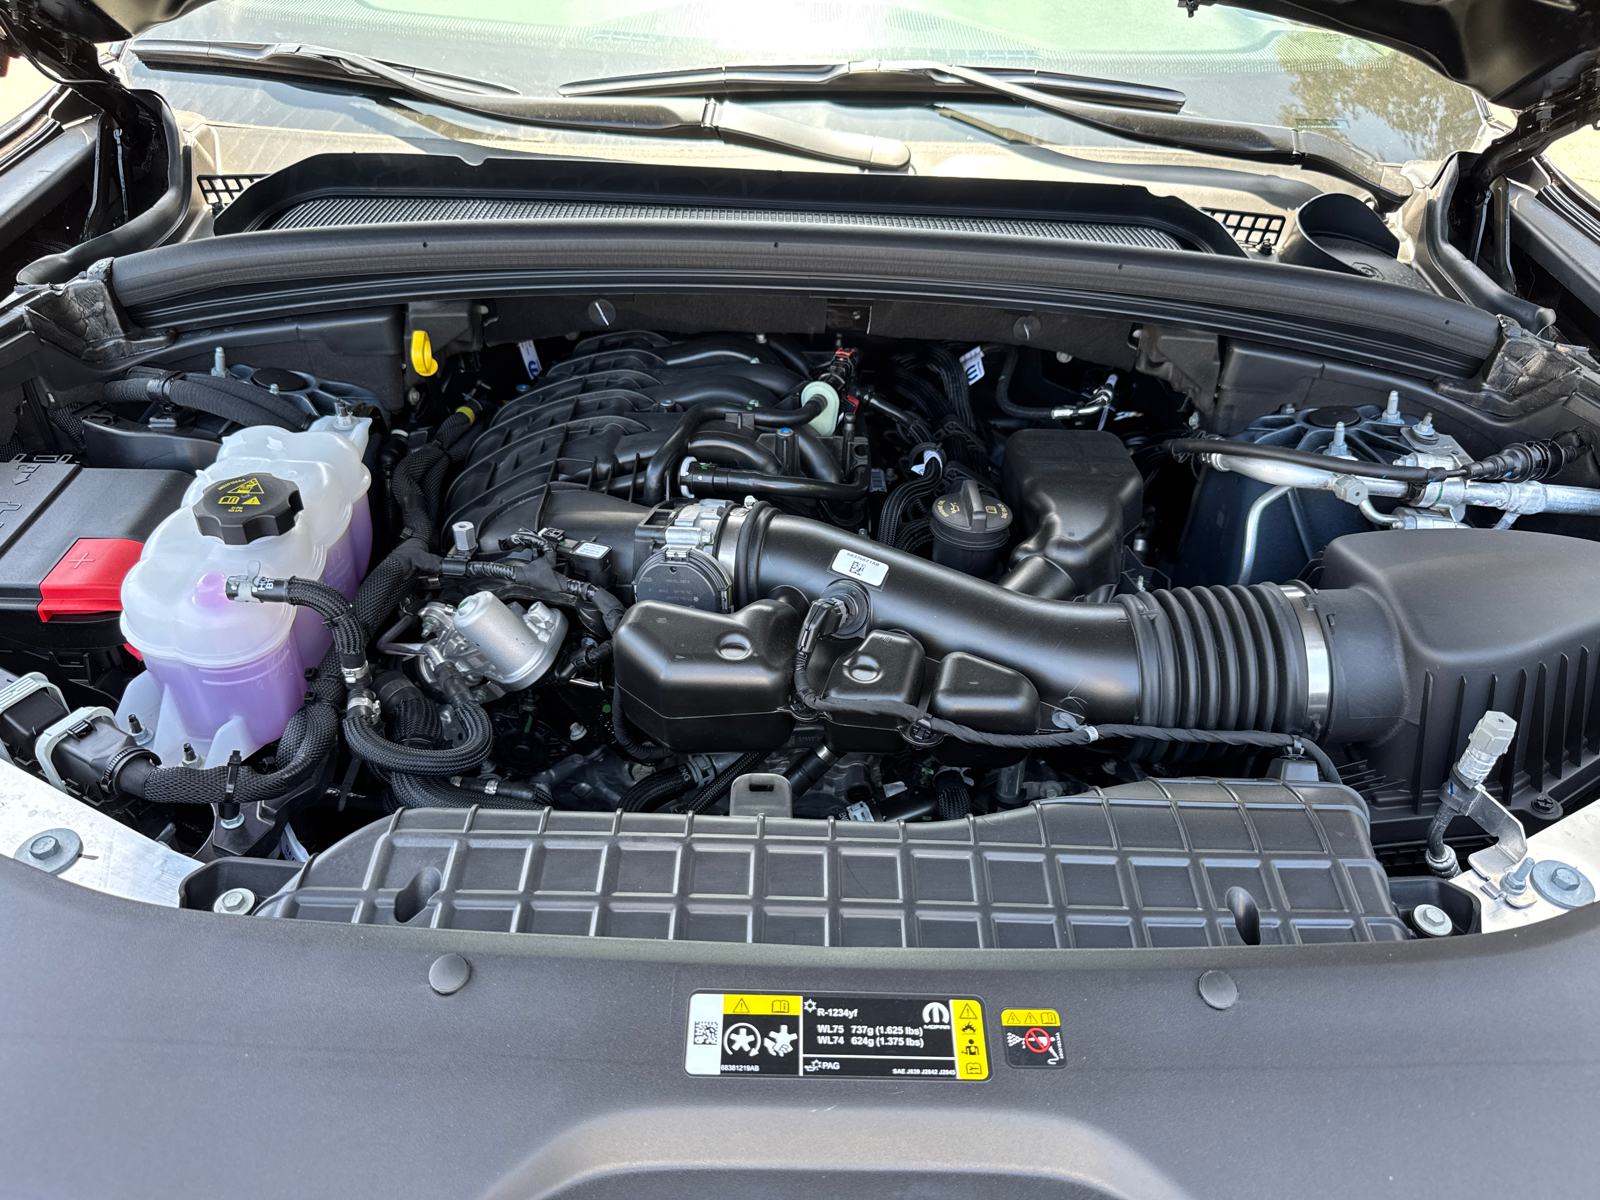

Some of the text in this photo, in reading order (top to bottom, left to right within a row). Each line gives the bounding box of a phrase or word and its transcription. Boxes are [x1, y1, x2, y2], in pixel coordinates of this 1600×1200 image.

[679, 765, 691, 781] ENG
[817, 1008, 858, 1019] R-1234yf
[817, 1025, 924, 1038] WL75 737g (1.625 lbs)
[817, 1036, 925, 1049] WL74 624g (1.375 lbs)
[822, 1062, 840, 1070] PAG
